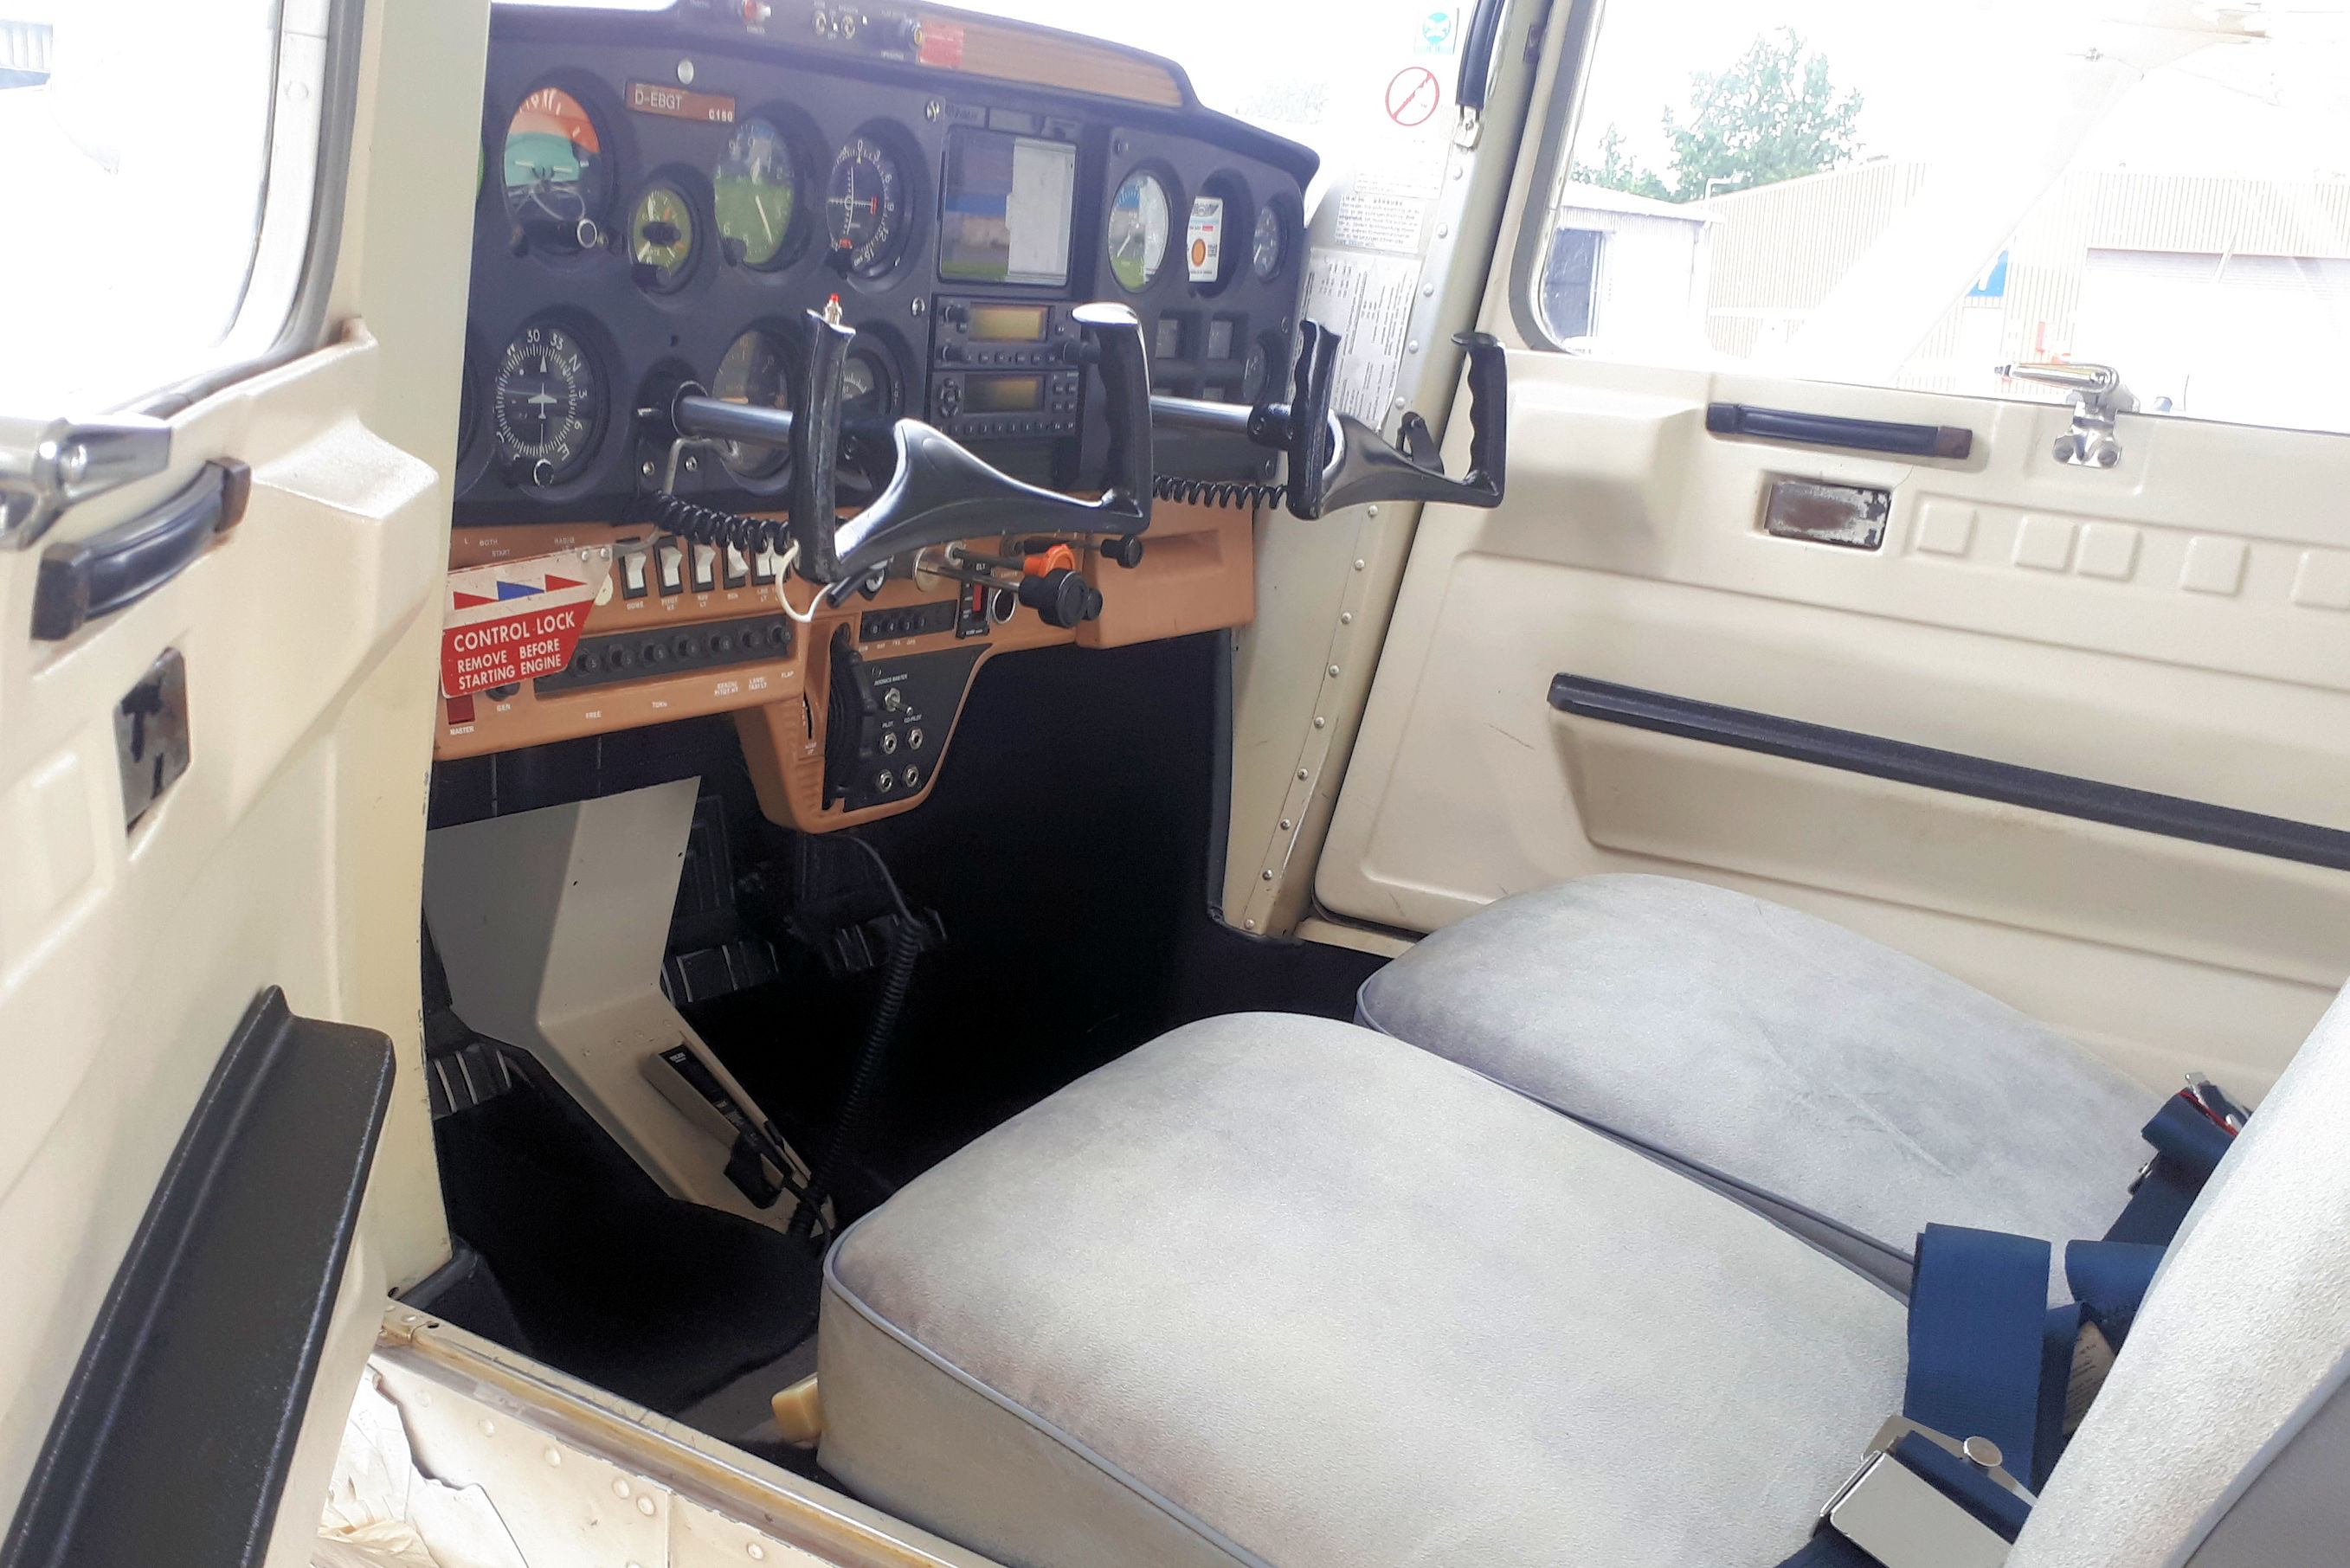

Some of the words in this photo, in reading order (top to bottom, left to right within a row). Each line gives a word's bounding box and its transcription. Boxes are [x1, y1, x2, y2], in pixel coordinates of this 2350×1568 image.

[634, 89, 683, 110] D-EBGT
[527, 329, 540, 343] 30
[550, 332, 563, 350] 33
[569, 354, 582, 372] N
[975, 562, 986, 571] ELT
[454, 621, 531, 652] CONTROL
[537, 611, 576, 634] LOCK
[457, 650, 508, 673] REMOVE
[519, 639, 560, 659] BEFORE
[459, 665, 516, 691] STARTING
[520, 653, 562, 676] ENGINE
[497, 704, 511, 712] GEN
[450, 725, 474, 736] MASTER
